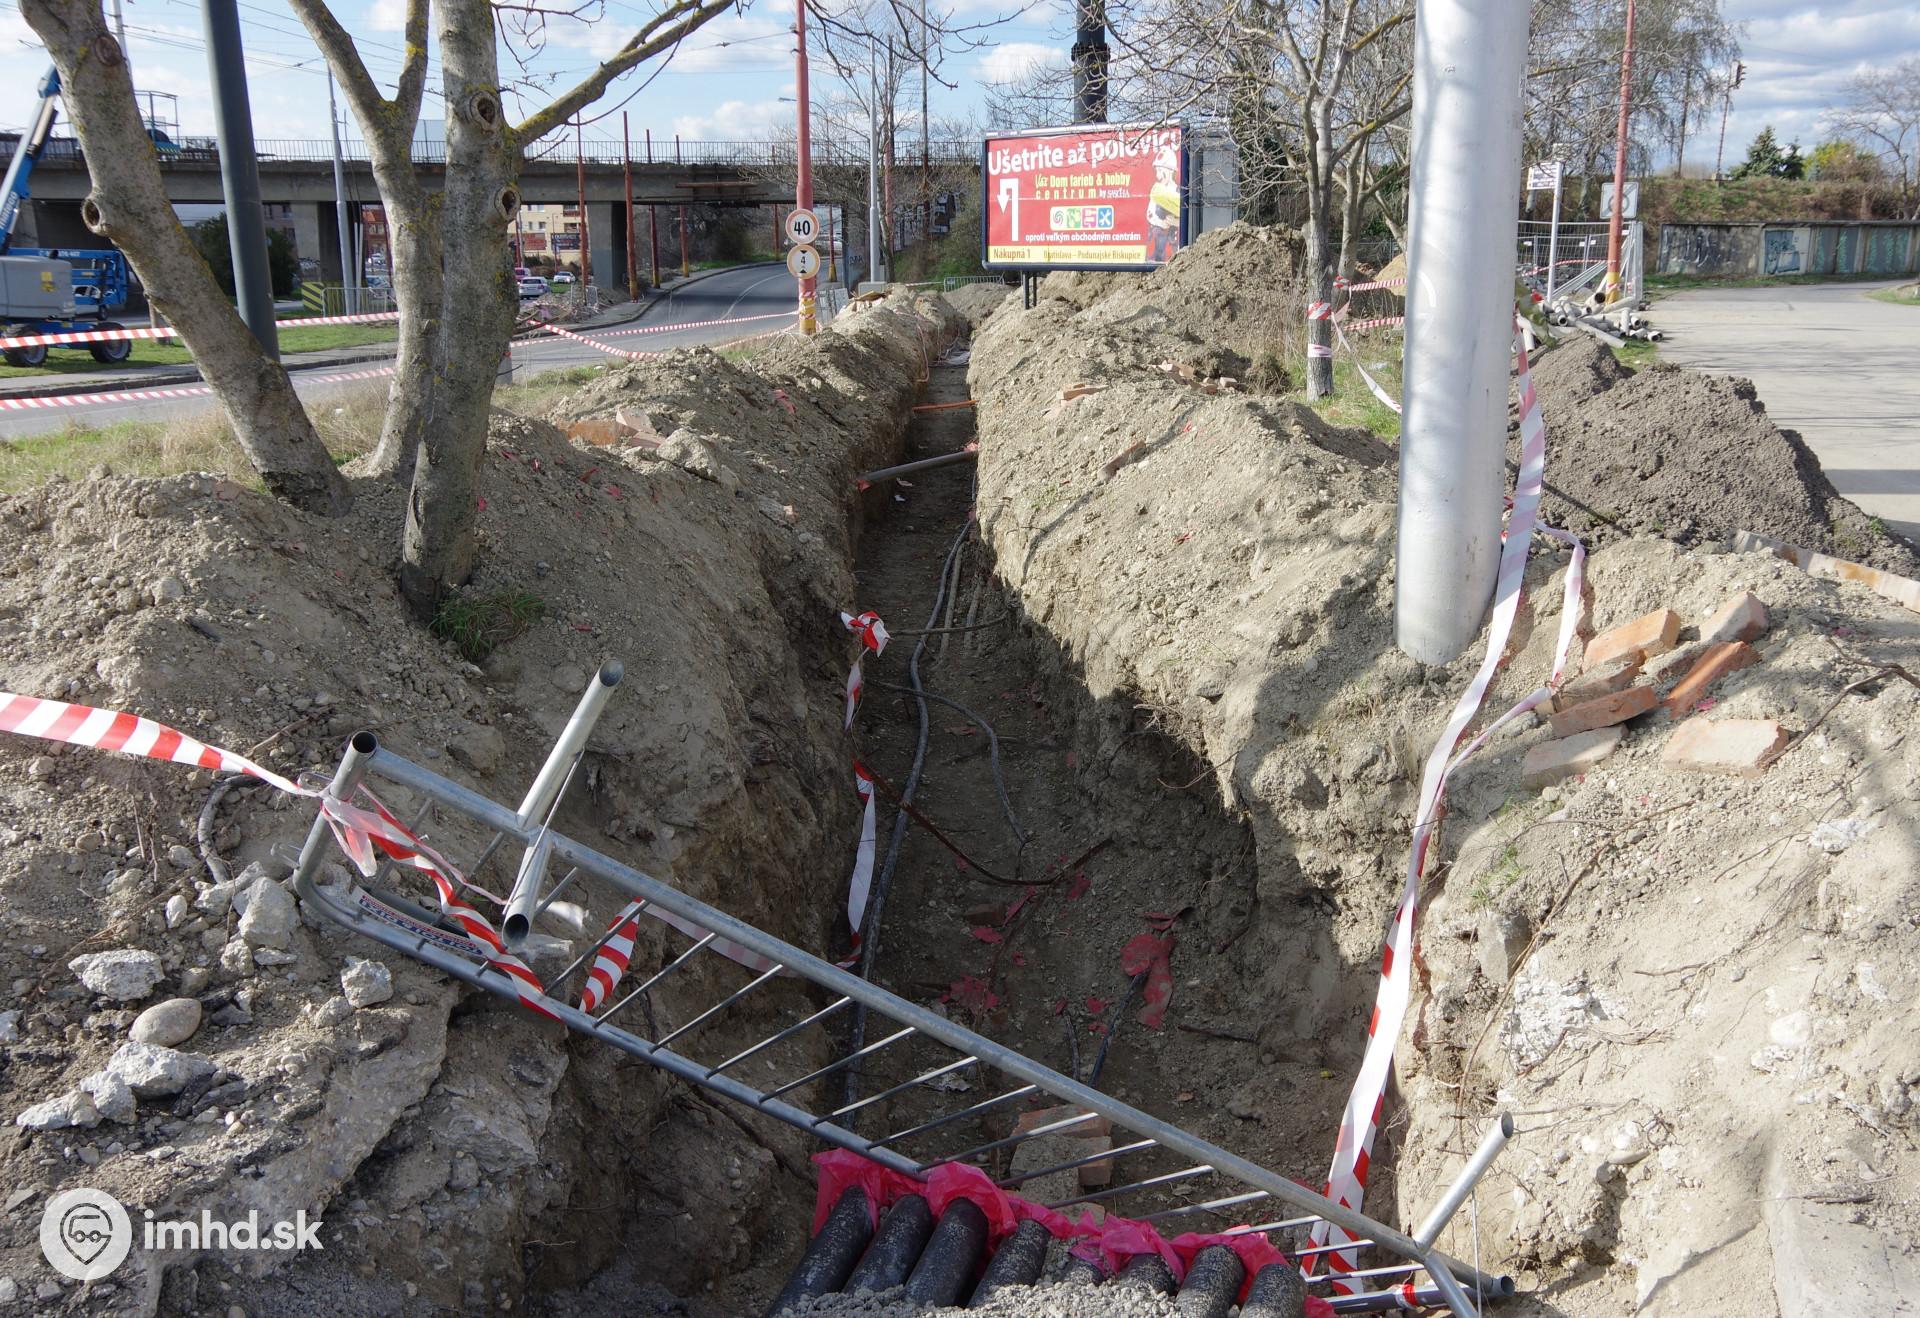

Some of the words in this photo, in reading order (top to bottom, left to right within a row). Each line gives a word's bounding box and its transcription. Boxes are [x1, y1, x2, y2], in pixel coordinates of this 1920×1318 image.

[988, 143, 1063, 175] Ušetrite
[1067, 143, 1088, 166] až
[1050, 175, 1068, 188] Dom
[1069, 173, 1094, 187] farieb
[1096, 173, 1103, 186] &
[1104, 171, 1131, 187] hobby
[1035, 187, 1097, 200] centrum
[794, 220, 810, 236] 40
[1025, 232, 1046, 244] oproti
[1071, 231, 1111, 244] obchodným
[800, 256, 806, 264] 4
